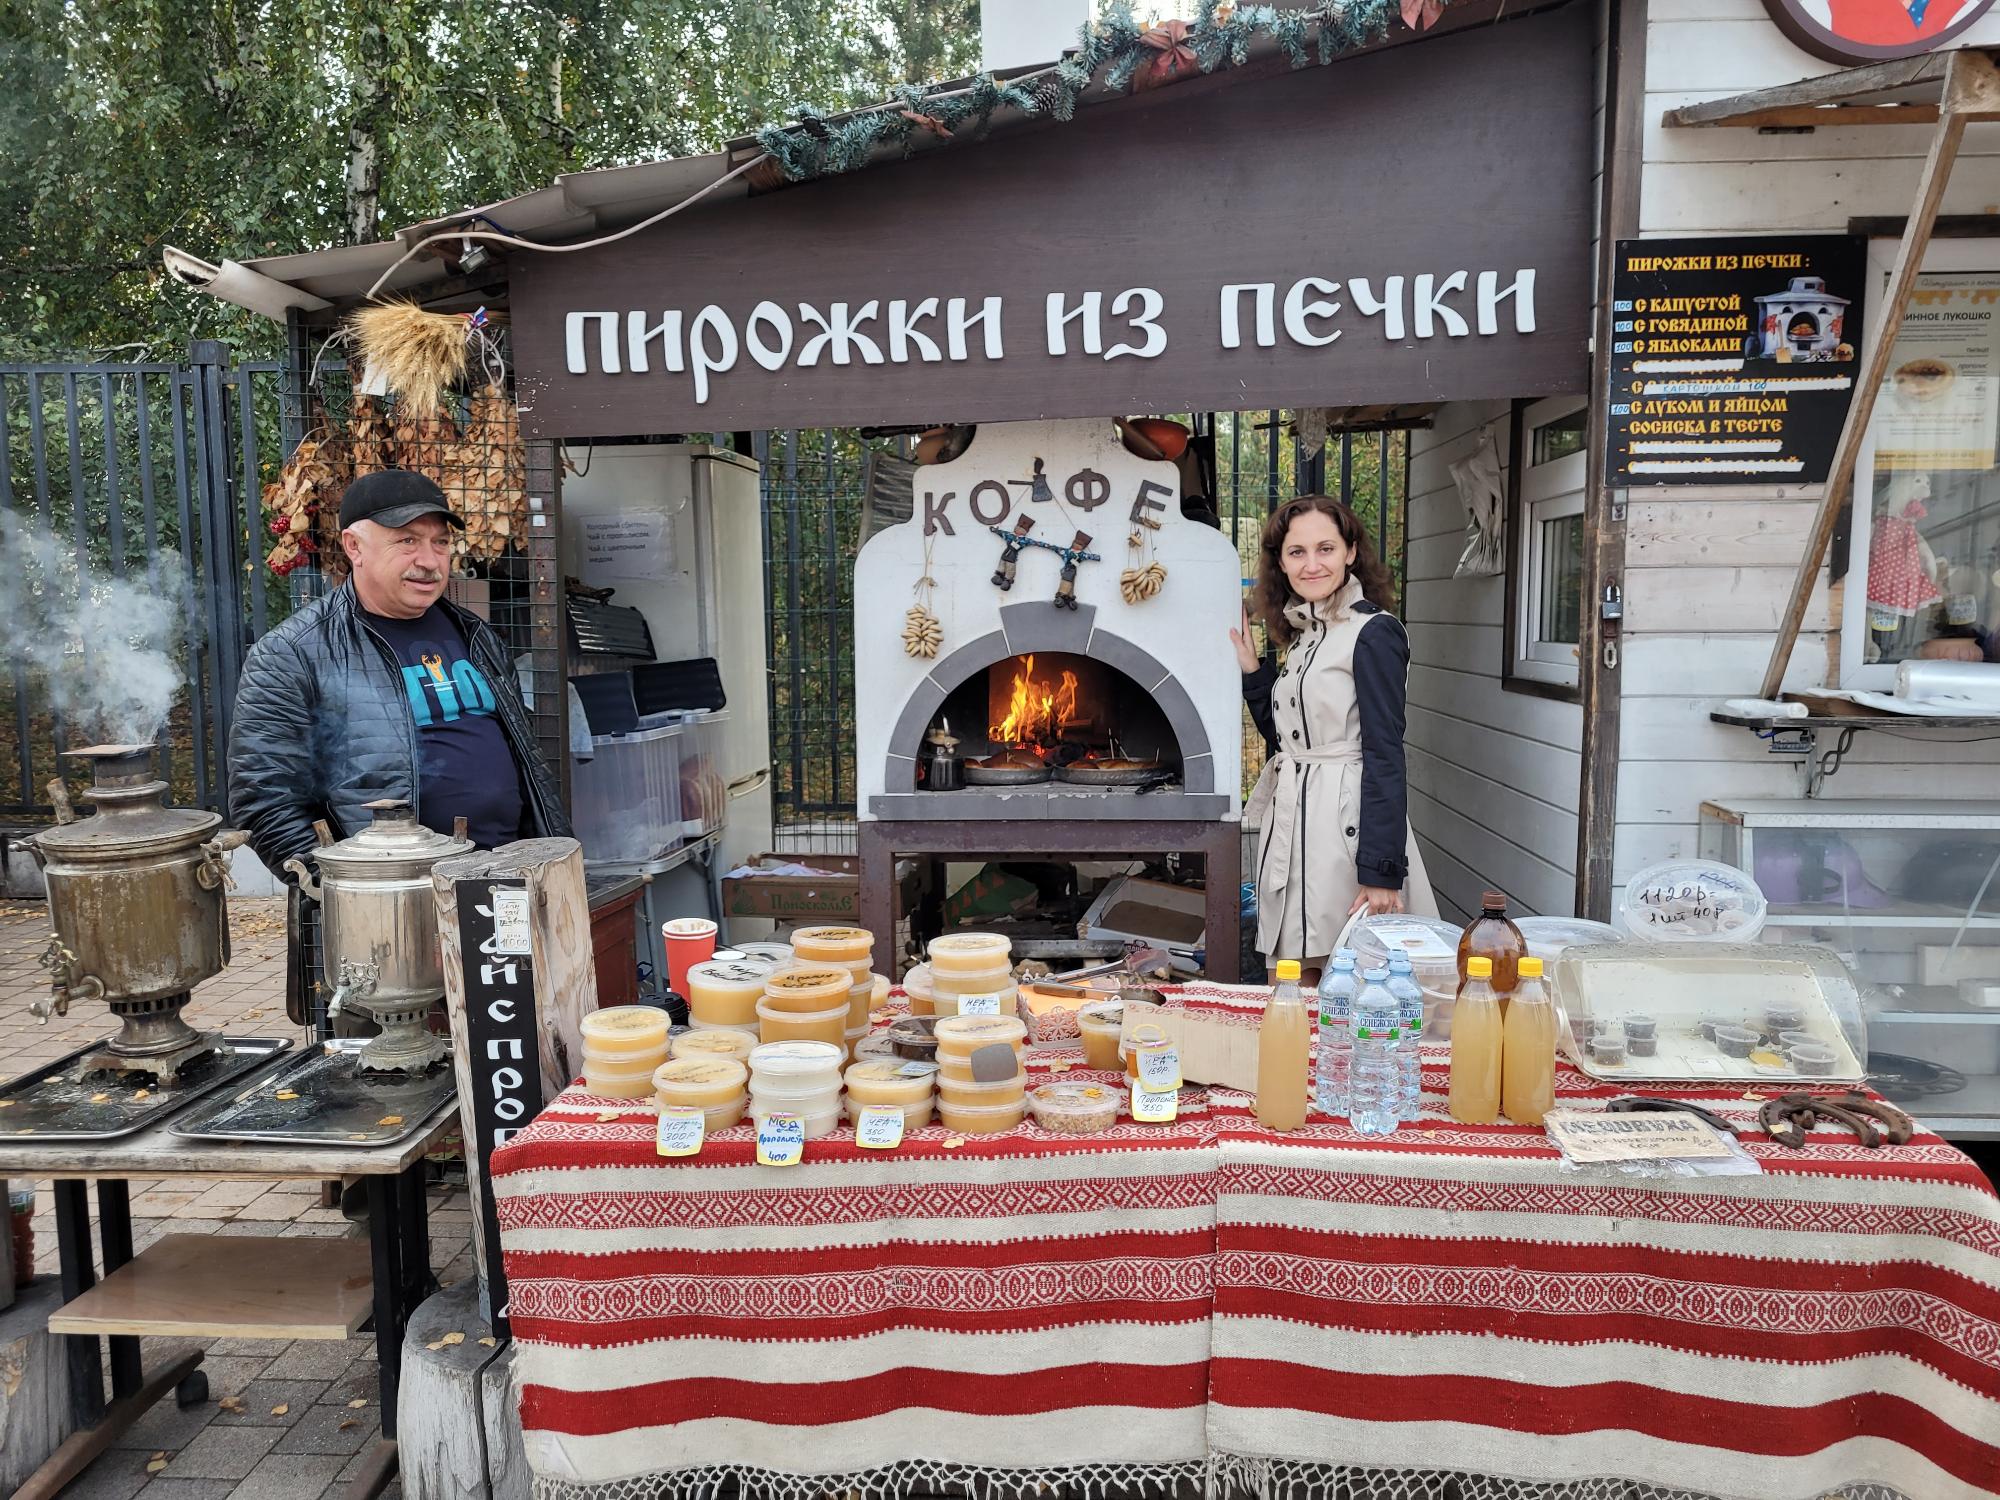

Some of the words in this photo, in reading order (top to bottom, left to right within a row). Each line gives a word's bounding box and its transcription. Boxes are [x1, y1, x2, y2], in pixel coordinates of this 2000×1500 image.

[1627, 256, 1712, 272] ПИРОЖКИ
[1715, 255, 1738, 271] ИЗ
[1635, 298, 1647, 312] С
[1649, 294, 1741, 315] КАПУСТОЙ
[1634, 318, 1646, 333] С
[1649, 314, 1748, 334] ГОВЯДИНОЙ
[1904, 312, 1940, 321] ИННОЕ
[1942, 312, 1992, 321] ЛУКОШКО
[1633, 339, 1645, 353] С
[1648, 337, 1742, 353] ЯБЛОКАМИ
[1631, 400, 1643, 415] С
[1644, 399, 1704, 417] ЛУКОМ
[1708, 399, 1721, 413] И
[1723, 396, 1788, 413] ЯЙЦОМ
[1629, 418, 1705, 435] СОСИСКА
[1709, 419, 1721, 433] В
[1724, 417, 1784, 433] ТЕСТЕ
[924, 468, 1174, 536] КОФЕ
[1360, 1017, 1399, 1028] СЕНЕЖСКАЯ
[768, 1151, 788, 1162] 400
